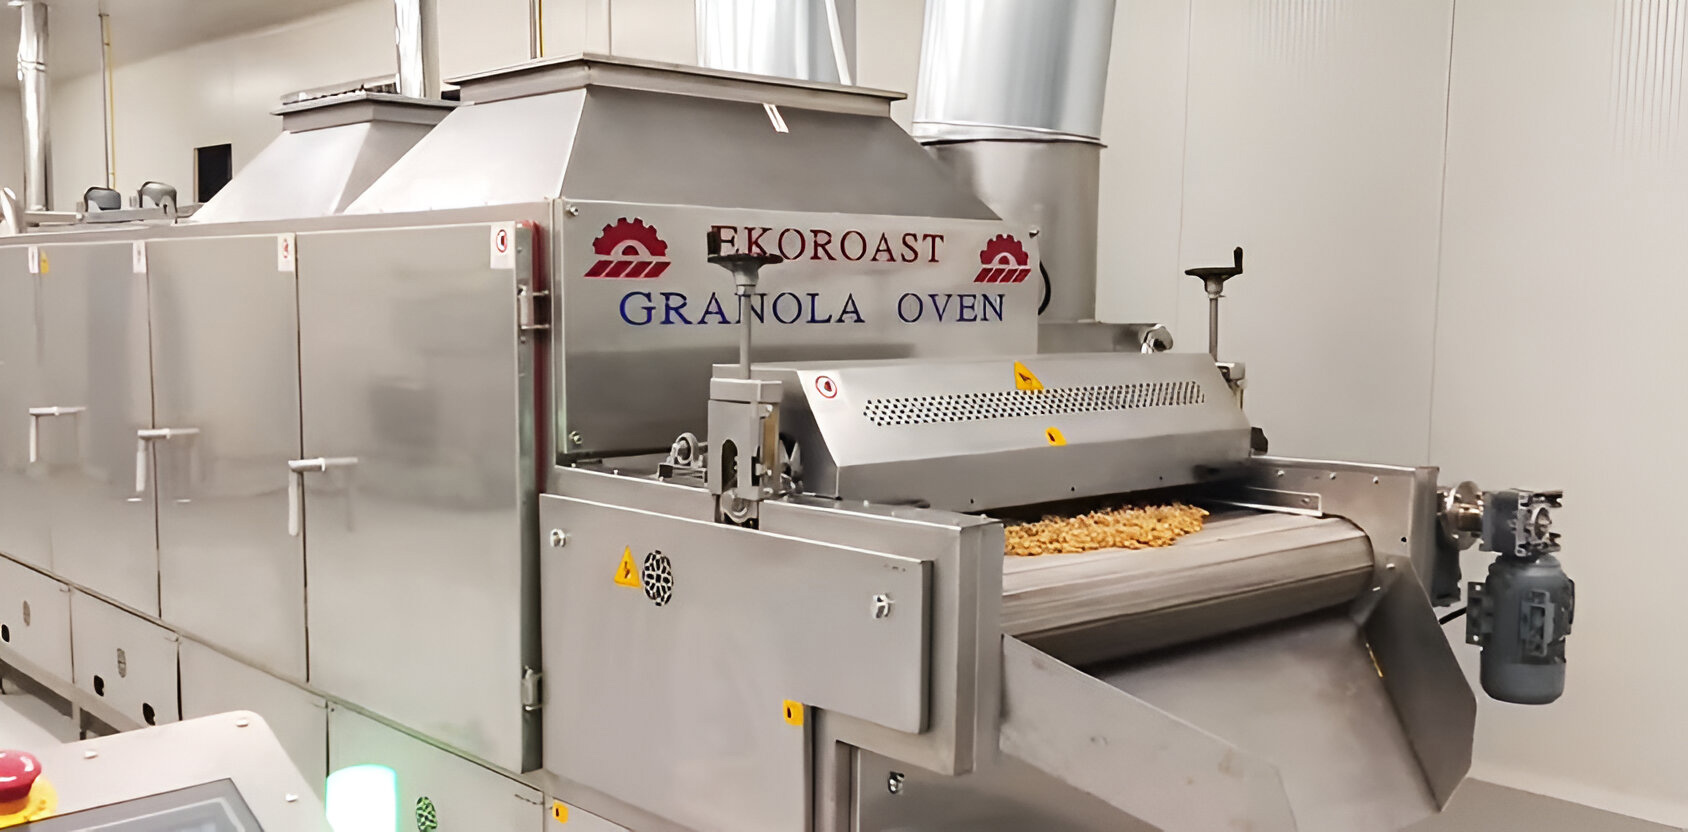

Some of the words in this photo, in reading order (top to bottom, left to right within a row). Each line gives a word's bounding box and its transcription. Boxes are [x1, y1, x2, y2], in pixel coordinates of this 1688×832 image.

[711, 225, 944, 263] EKOROAST
[619, 291, 865, 325] GRANOLA
[897, 292, 1005, 323] OVEN
